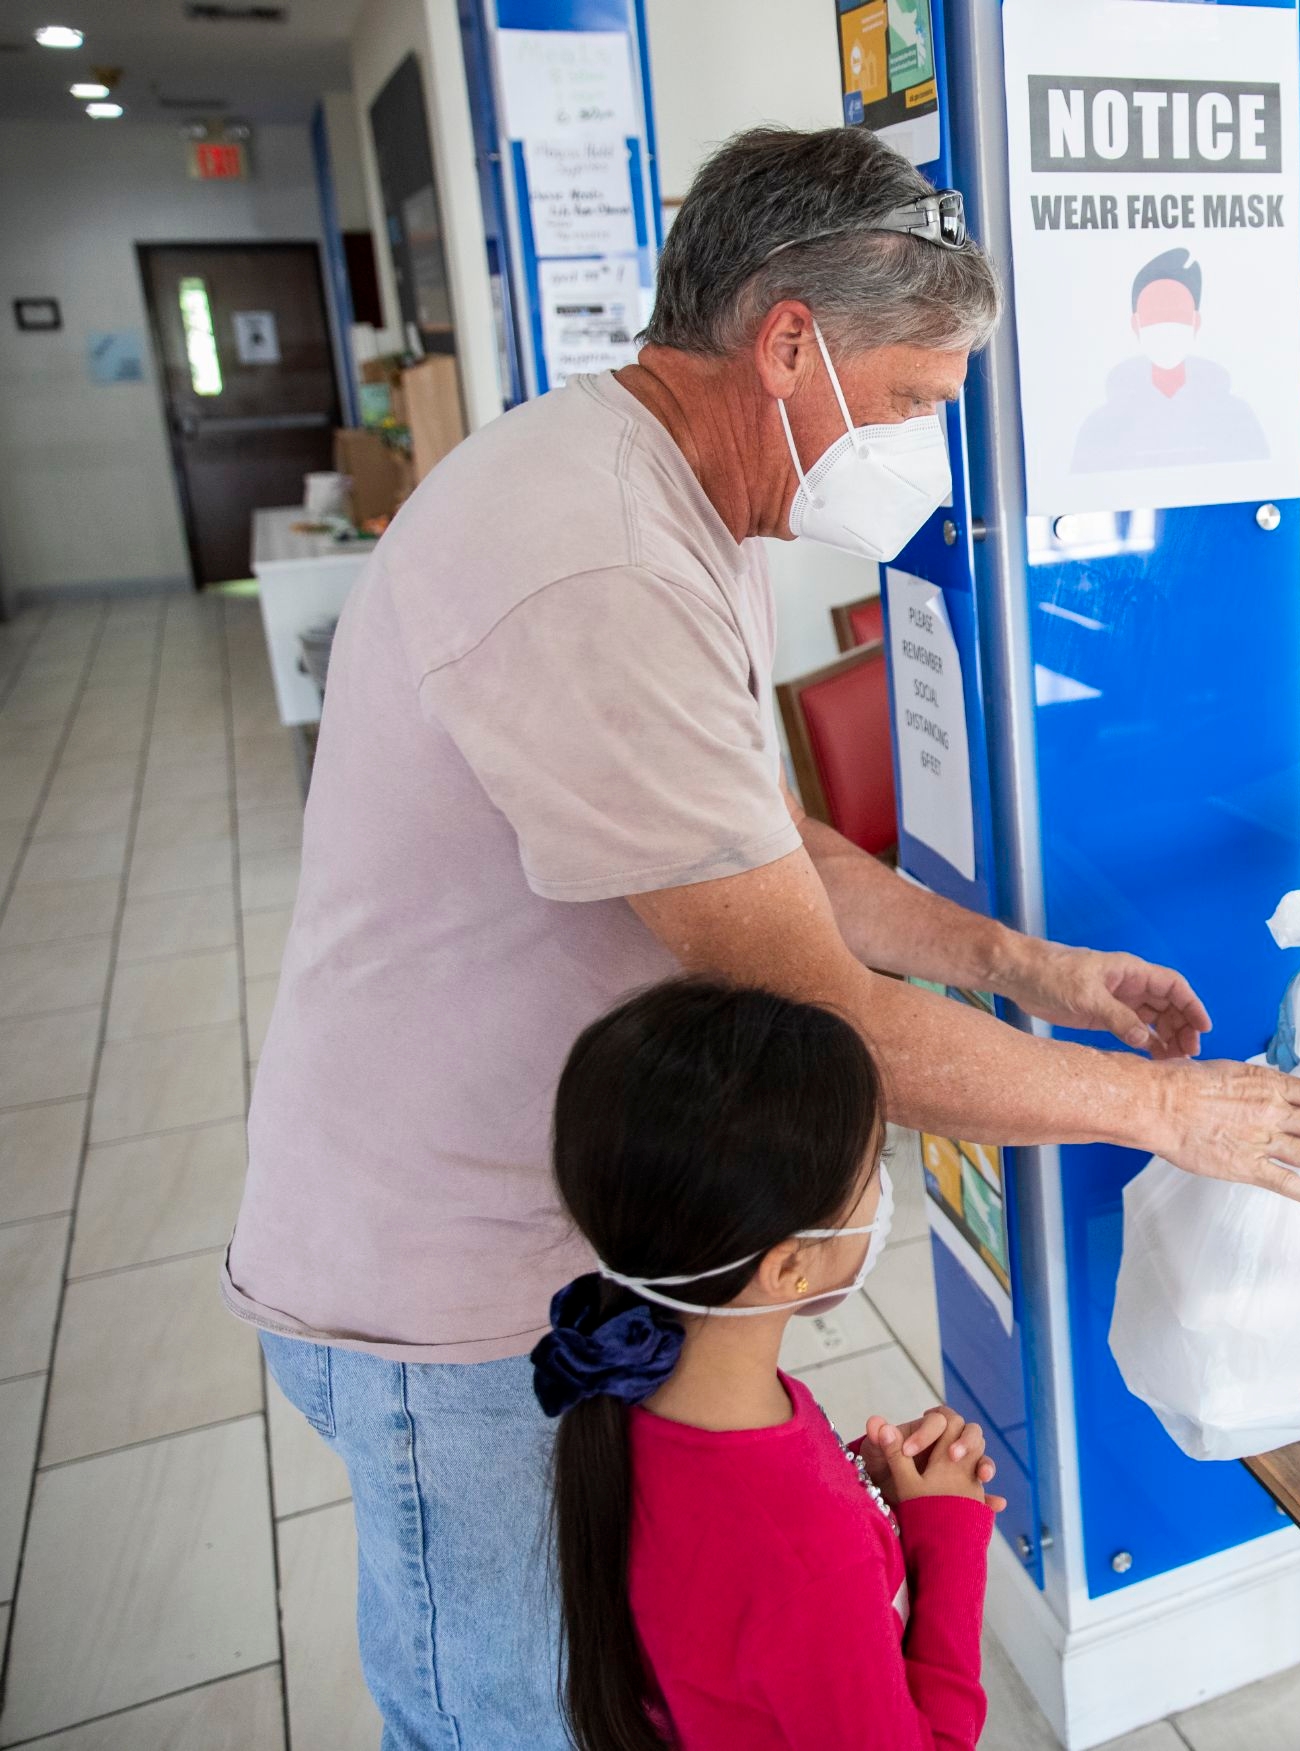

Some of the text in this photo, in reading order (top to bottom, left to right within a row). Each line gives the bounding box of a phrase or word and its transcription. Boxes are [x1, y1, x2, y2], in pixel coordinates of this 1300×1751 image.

[1048, 88, 1267, 161] NOTICE
[1030, 194, 1285, 231] WEAR FACE MASK
[909, 606, 934, 634] PLEASE
[902, 639, 944, 675] REMEMBER
[913, 678, 940, 708] SOCIAL
[905, 708, 949, 750] DISTANCING
